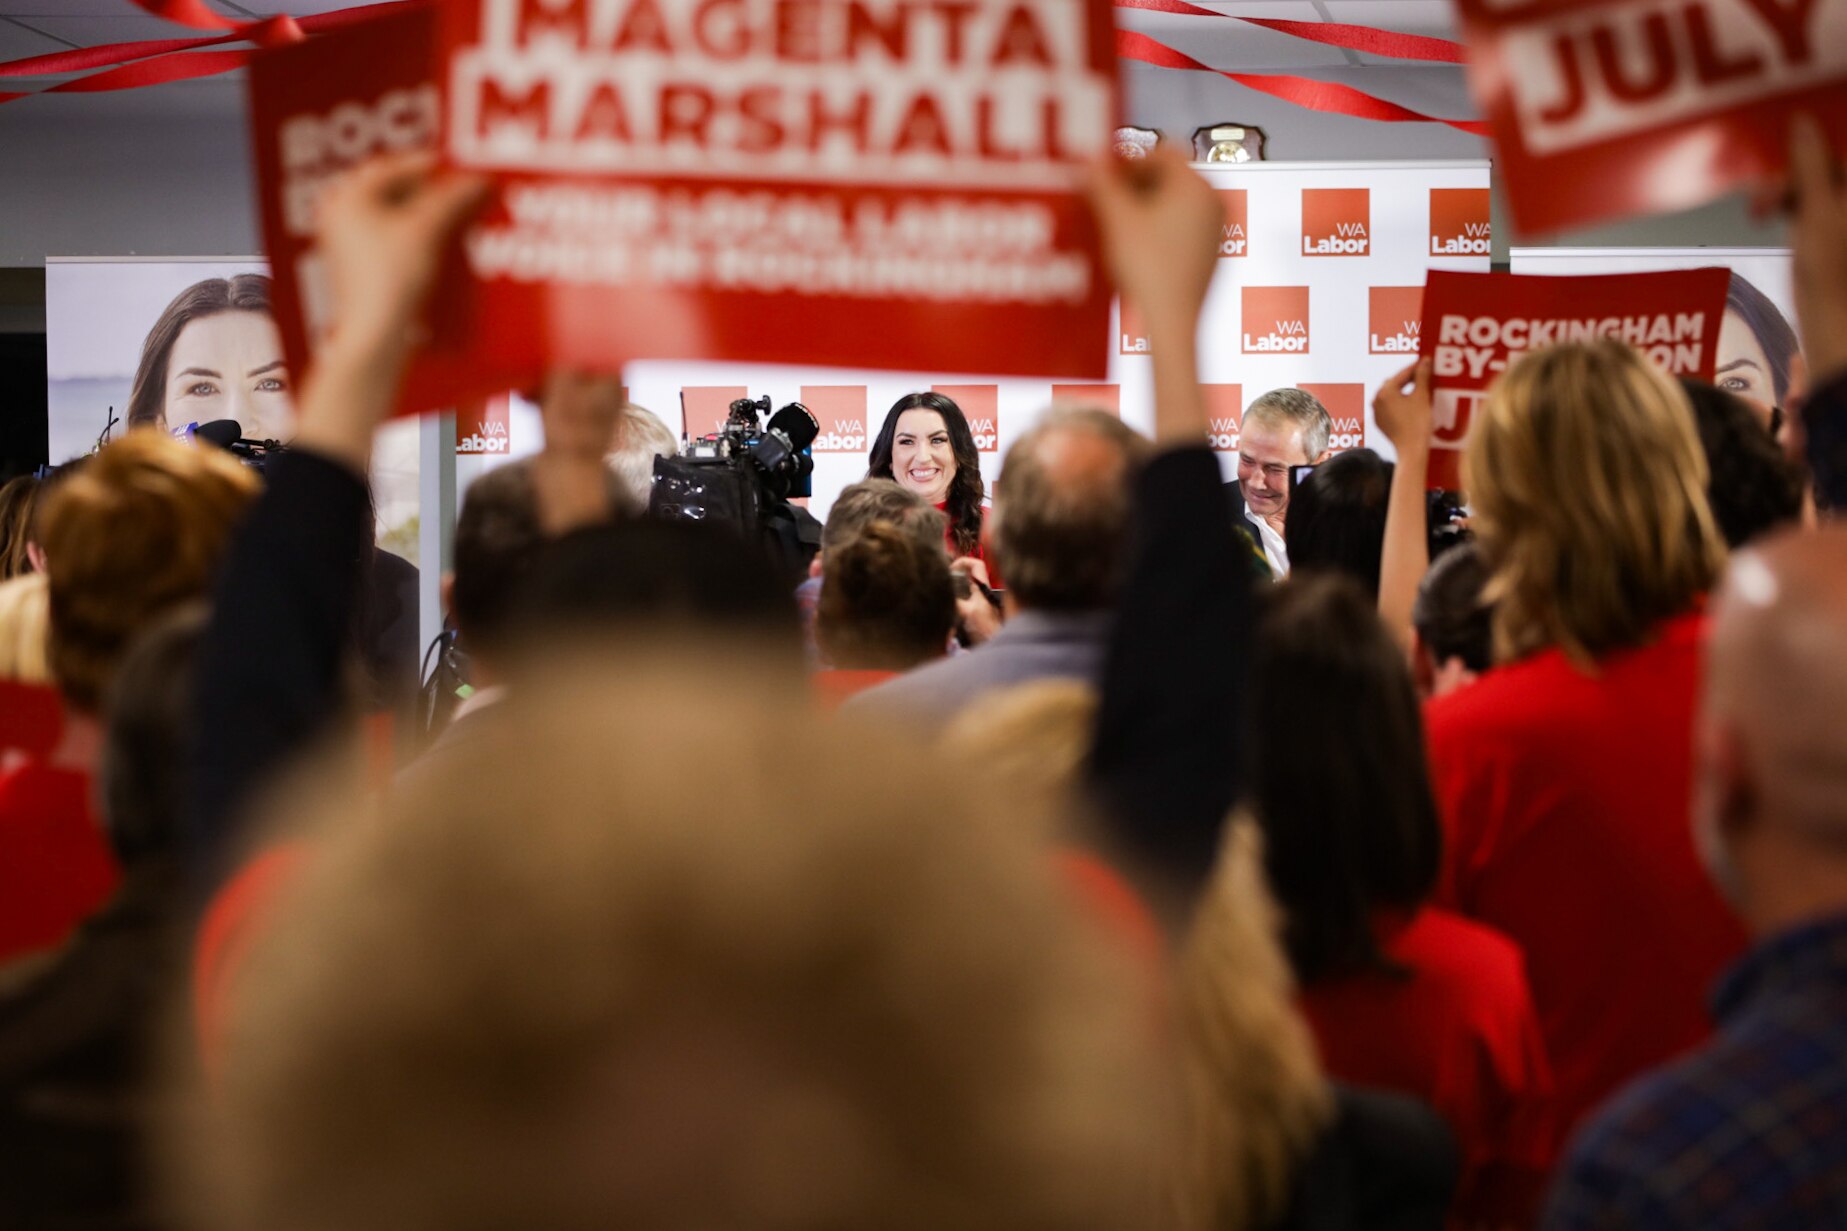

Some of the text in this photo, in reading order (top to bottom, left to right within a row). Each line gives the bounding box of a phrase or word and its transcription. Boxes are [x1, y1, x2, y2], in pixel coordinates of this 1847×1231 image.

[517, 0, 1054, 68] MAGENTA
[1539, 0, 1820, 125] JULY
[474, 75, 1087, 165] MARSHALL
[1336, 222, 1366, 237] WA
[1304, 234, 1368, 254] Labor
[1275, 320, 1306, 335] WA
[1403, 320, 1422, 335] W
[1438, 312, 1705, 349] ROCKINGHAM
[1243, 332, 1307, 352] Labor
[1371, 332, 1421, 352] Labo
[478, 421, 506, 436] WA
[834, 419, 865, 434] WA
[1209, 417, 1240, 433] WA
[1330, 417, 1362, 432] WA
[456, 433, 508, 452] abor
[811, 431, 865, 450] abor
